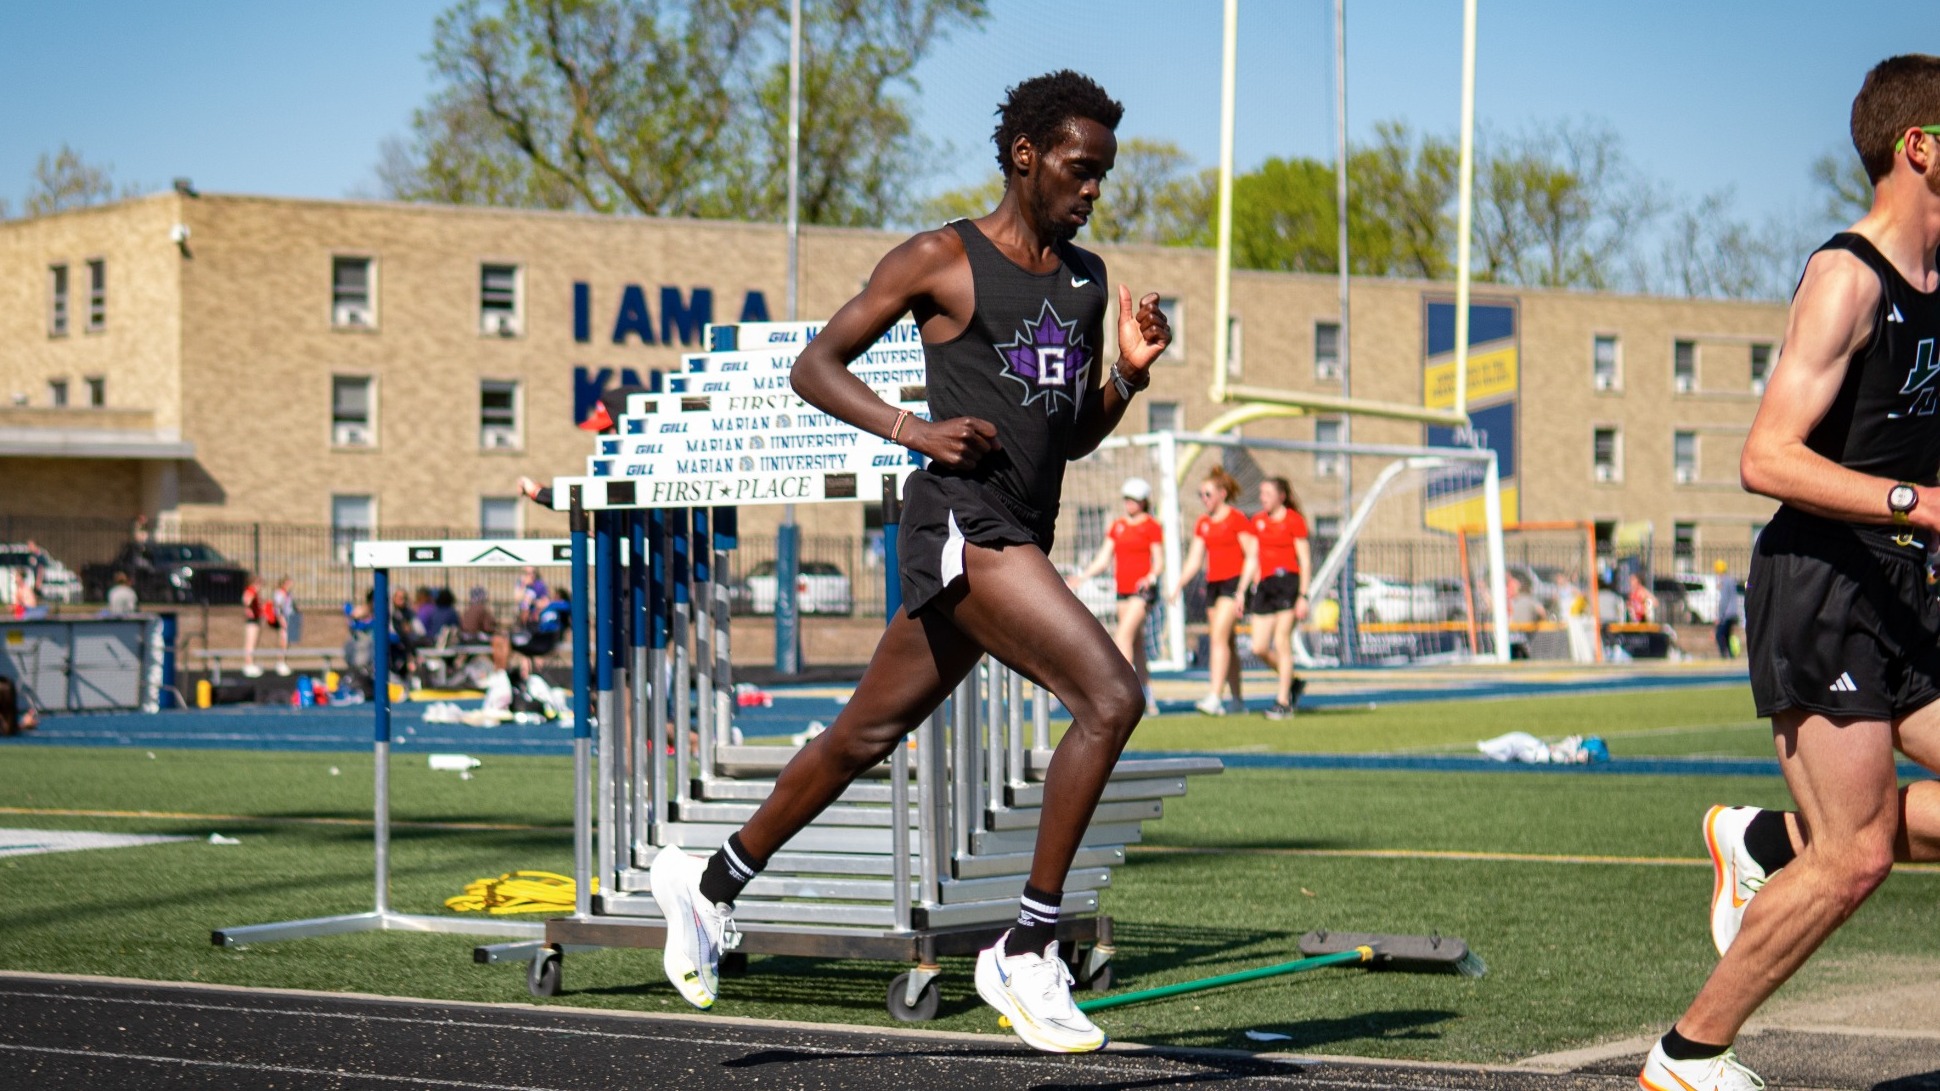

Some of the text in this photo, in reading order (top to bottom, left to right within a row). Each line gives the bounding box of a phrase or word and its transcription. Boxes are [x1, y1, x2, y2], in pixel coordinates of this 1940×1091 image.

[573, 281, 590, 343] I
[612, 283, 714, 347] AM
[768, 331, 798, 343] GILL
[721, 361, 748, 373] GILL
[1037, 347, 1067, 386] G
[703, 381, 730, 393] GILL
[660, 422, 688, 434] GILL
[712, 416, 770, 431] MARIAN
[635, 433, 858, 455] GILL MARIAN UNIVERSITY
[626, 454, 902, 475] GILL MARIAN UNIVERSITY GILL
[651, 476, 812, 502] FIRST PLACE
